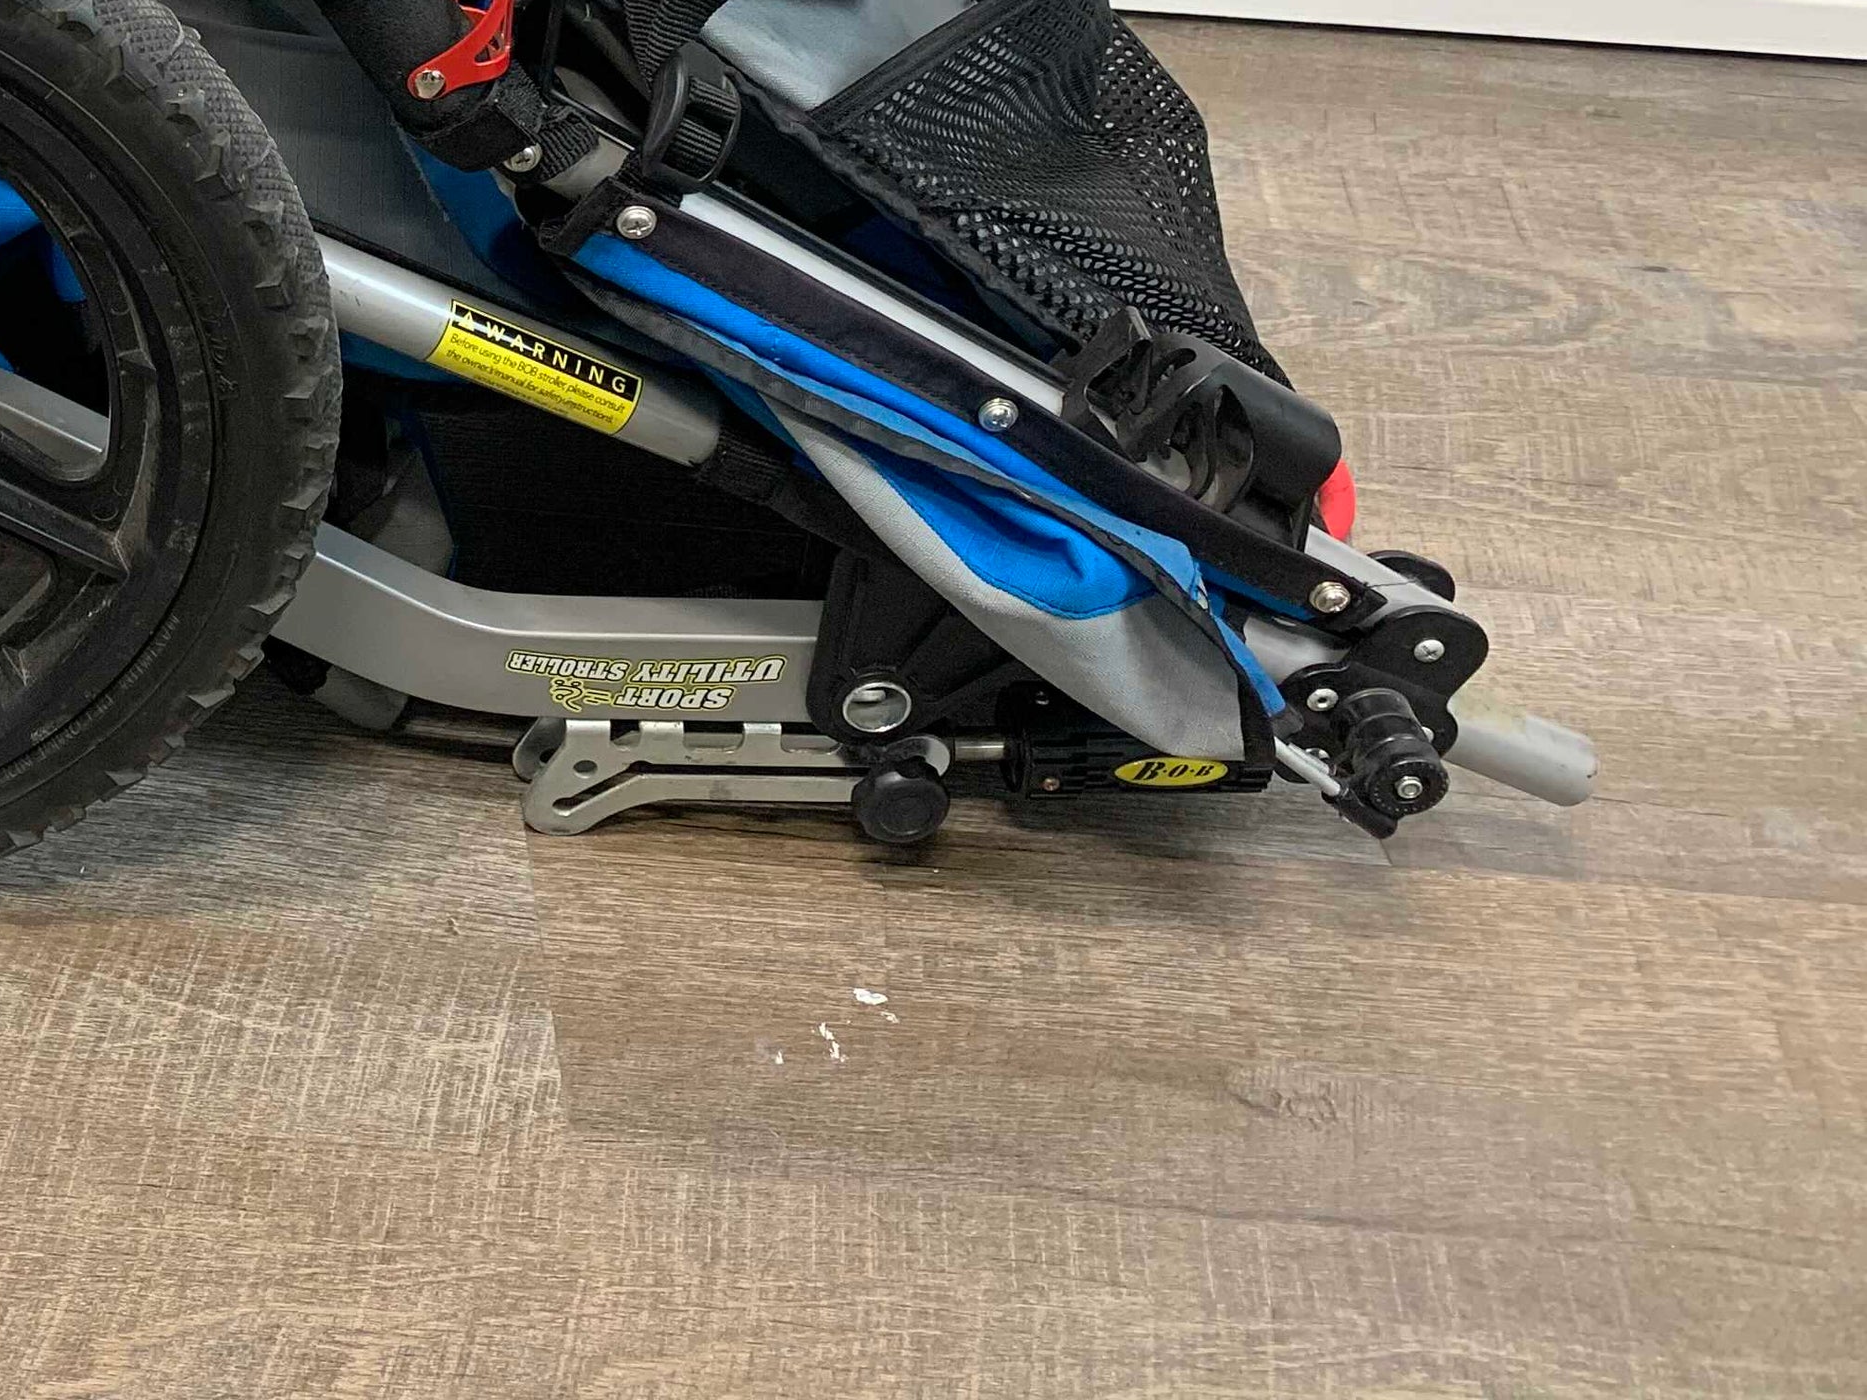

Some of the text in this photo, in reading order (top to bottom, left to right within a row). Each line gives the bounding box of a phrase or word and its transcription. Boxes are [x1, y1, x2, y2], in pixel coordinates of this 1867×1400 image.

[445, 349, 462, 362] the
[494, 368, 527, 388] manual
[525, 378, 539, 393] for
[538, 386, 566, 406] safety
[449, 333, 479, 353] Before
[478, 346, 503, 365] using
[502, 355, 518, 369] the
[517, 361, 539, 377] BOB
[566, 383, 595, 402] please
[594, 396, 626, 414] consult
[486, 320, 627, 394] WARNING
[508, 651, 785, 684] UTILITY STROLLER
[612, 685, 735, 710] SPORT
